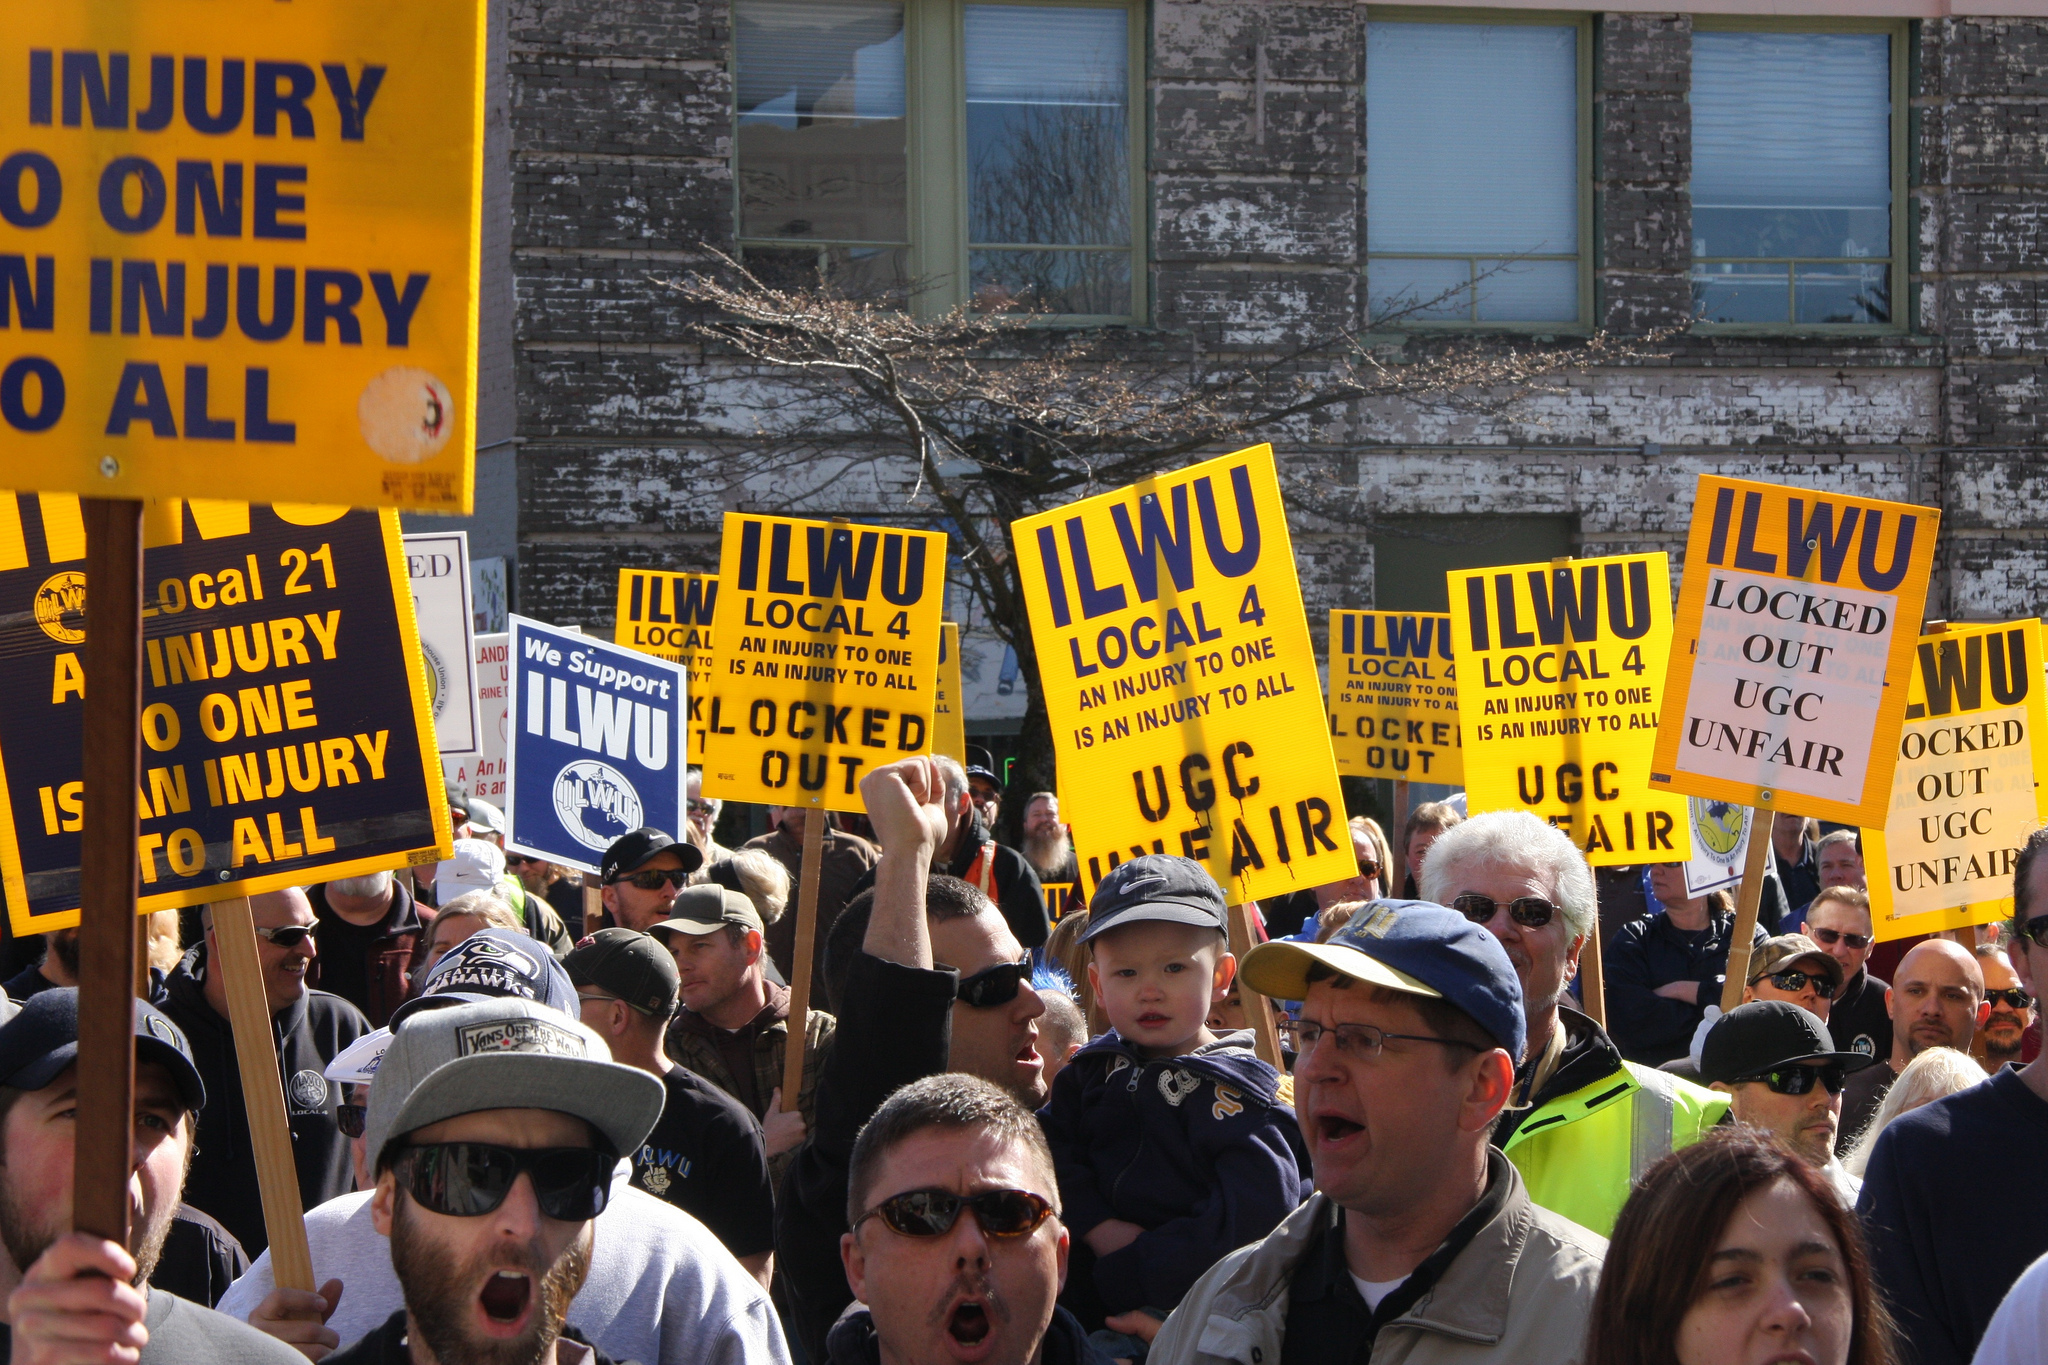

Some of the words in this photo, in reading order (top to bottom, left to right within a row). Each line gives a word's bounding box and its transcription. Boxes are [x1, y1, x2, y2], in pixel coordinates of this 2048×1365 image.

[29, 48, 387, 142] INJURY
[0, 150, 62, 230] O
[99, 155, 307, 243] ONE
[0, 253, 55, 333] N
[89, 257, 431, 349] INJURY
[0, 355, 66, 434] O
[105, 360, 297, 445] ALL
[737, 520, 928, 607] ILWU
[1036, 464, 1262, 629] ILWU
[1706, 487, 1918, 593] ILWU
[39, 588, 86, 622] ILW
[144, 553, 264, 618] ocal
[279, 543, 337, 597] 21
[629, 574, 719, 627] ILW
[744, 597, 873, 637] LOCAL
[887, 610, 911, 641] 4
[1466, 561, 1652, 651] ILWU
[1707, 578, 1888, 636] LOCKED
[146, 609, 342, 688] INJURY
[634, 626, 714, 650] LOCAL
[739, 636, 767, 654] AN
[772, 638, 838, 660] INJURY
[845, 645, 870, 662] TO
[875, 648, 912, 667] ONE
[1069, 600, 1224, 679] LOCAL
[1238, 584, 1266, 628] 4
[1742, 634, 1834, 675] OUT
[525, 636, 563, 667] We
[567, 651, 670, 700] Support
[729, 659, 746, 675] IS
[752, 660, 779, 678] AN
[784, 662, 849, 684] INJURY
[853, 669, 878, 688] TO
[885, 672, 917, 692] ALL
[1079, 685, 1108, 712] AN
[1113, 660, 1188, 700] INJURY
[1195, 650, 1224, 678] TO
[1230, 637, 1276, 669] ONE
[1346, 679, 1364, 691] AN
[1368, 681, 1412, 695] INJURY
[1416, 684, 1433, 695] TO
[1347, 658, 1436, 681] LOCAL
[1481, 647, 1610, 689] LOCAL
[1622, 645, 1646, 677] 4
[141, 702, 182, 752] O
[199, 679, 318, 743] ONE
[527, 670, 669, 771] ILWU
[710, 695, 927, 753] LOCKED
[1074, 727, 1095, 750] IS
[1102, 716, 1131, 743] AN
[1136, 692, 1213, 735] INJURY
[1218, 683, 1248, 710] TO
[1256, 671, 1295, 701] ALL
[1340, 692, 1353, 703] IS
[1356, 694, 1374, 705] AN
[1377, 695, 1421, 709] INJURY
[1424, 699, 1441, 709] TO
[1484, 696, 1509, 715] AN
[1515, 692, 1578, 715] INJURY
[1583, 690, 1609, 708] TO
[1614, 687, 1652, 706] ONE
[1733, 677, 1824, 723] UGC
[1331, 714, 1461, 749] LOCKE
[1477, 723, 1493, 741] IS
[1500, 721, 1525, 740] AN
[1530, 715, 1591, 738] INJURY
[1597, 713, 1622, 732] TO
[1628, 711, 1659, 730] ALL
[1688, 717, 1844, 778] UNFAIR
[1898, 719, 2024, 761] OCKED
[204, 729, 389, 807] INJURY
[476, 760, 494, 777] An
[760, 750, 864, 795] OUT
[1132, 740, 1262, 827] UGC
[1367, 746, 1435, 774] OUT
[1517, 761, 1619, 806] UGC
[1917, 767, 1989, 801] OUT
[475, 780, 487, 796] is
[231, 806, 336, 868] ALL
[1919, 807, 1993, 844] UGC
[435, 966, 515, 982] SEATTLE
